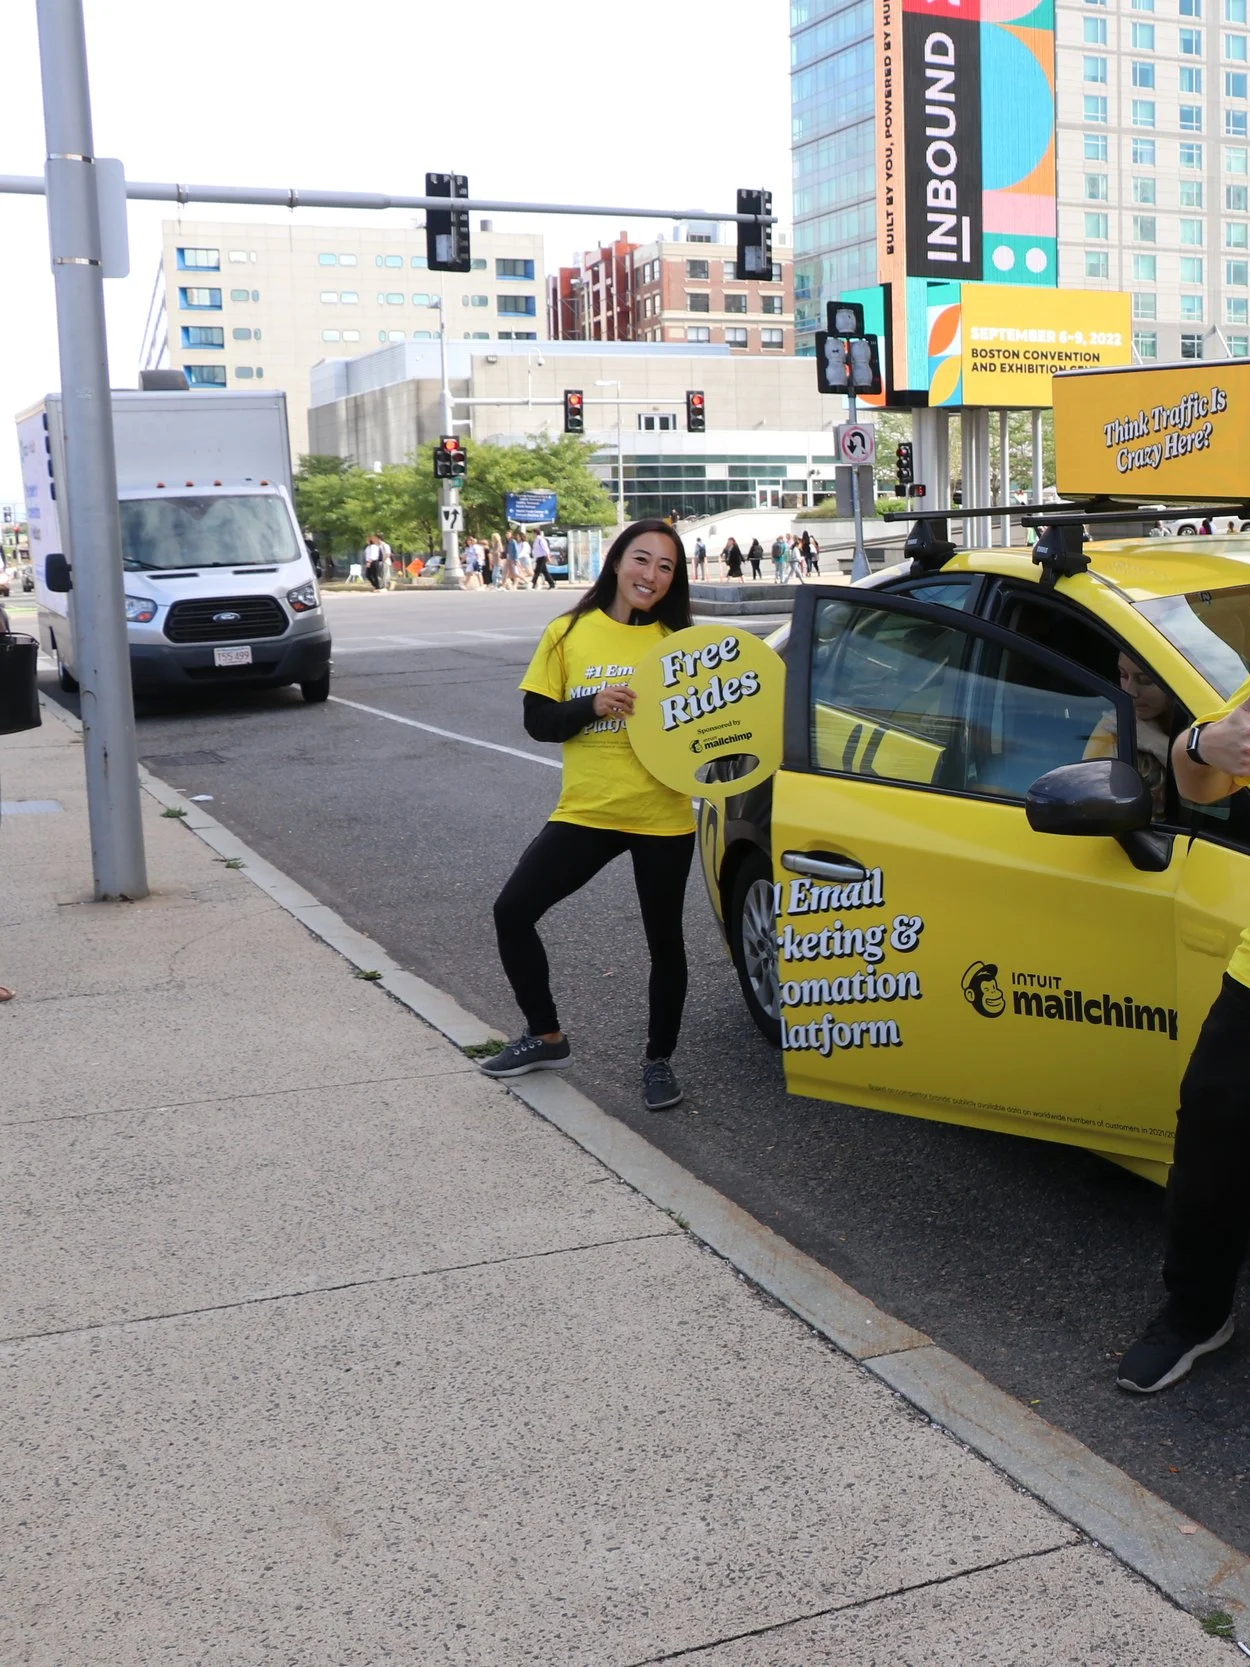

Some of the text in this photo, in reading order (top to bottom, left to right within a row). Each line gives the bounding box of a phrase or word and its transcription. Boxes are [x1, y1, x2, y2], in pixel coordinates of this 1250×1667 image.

[882, 0, 895, 255] BUILT BY YOU, POWERED BY HU
[924, 31, 958, 262] INBOUND
[970, 326, 1123, 346] SEPTEMBER 6-9, 2022
[971, 348, 1100, 362] BOSTON CONVENTION
[971, 362, 997, 373] AND
[1103, 386, 1228, 447] Think Traffic Is
[1116, 422, 1213, 474] Crazy Here?
[585, 665, 603, 680] #1
[660, 636, 740, 688] Free
[660, 670, 761, 732] Rides
[697, 719, 741, 734] Sponsored by
[704, 731, 753, 749] mailchimp
[787, 867, 886, 916] Email
[777, 914, 925, 964] keting &
[779, 964, 923, 1006] omation
[1011, 971, 1062, 990] INTUIT
[780, 1013, 903, 1058] latform
[977, 1101, 1006, 1111] available
[1006, 1105, 1021, 1115] data
[1032, 1110, 1067, 1121] worldwide
[1067, 1116, 1096, 1126] numbers
[1105, 1122, 1140, 1133] customers
[1141, 1126, 1148, 1134] in
[1149, 1127, 1176, 1139] 2021/20
